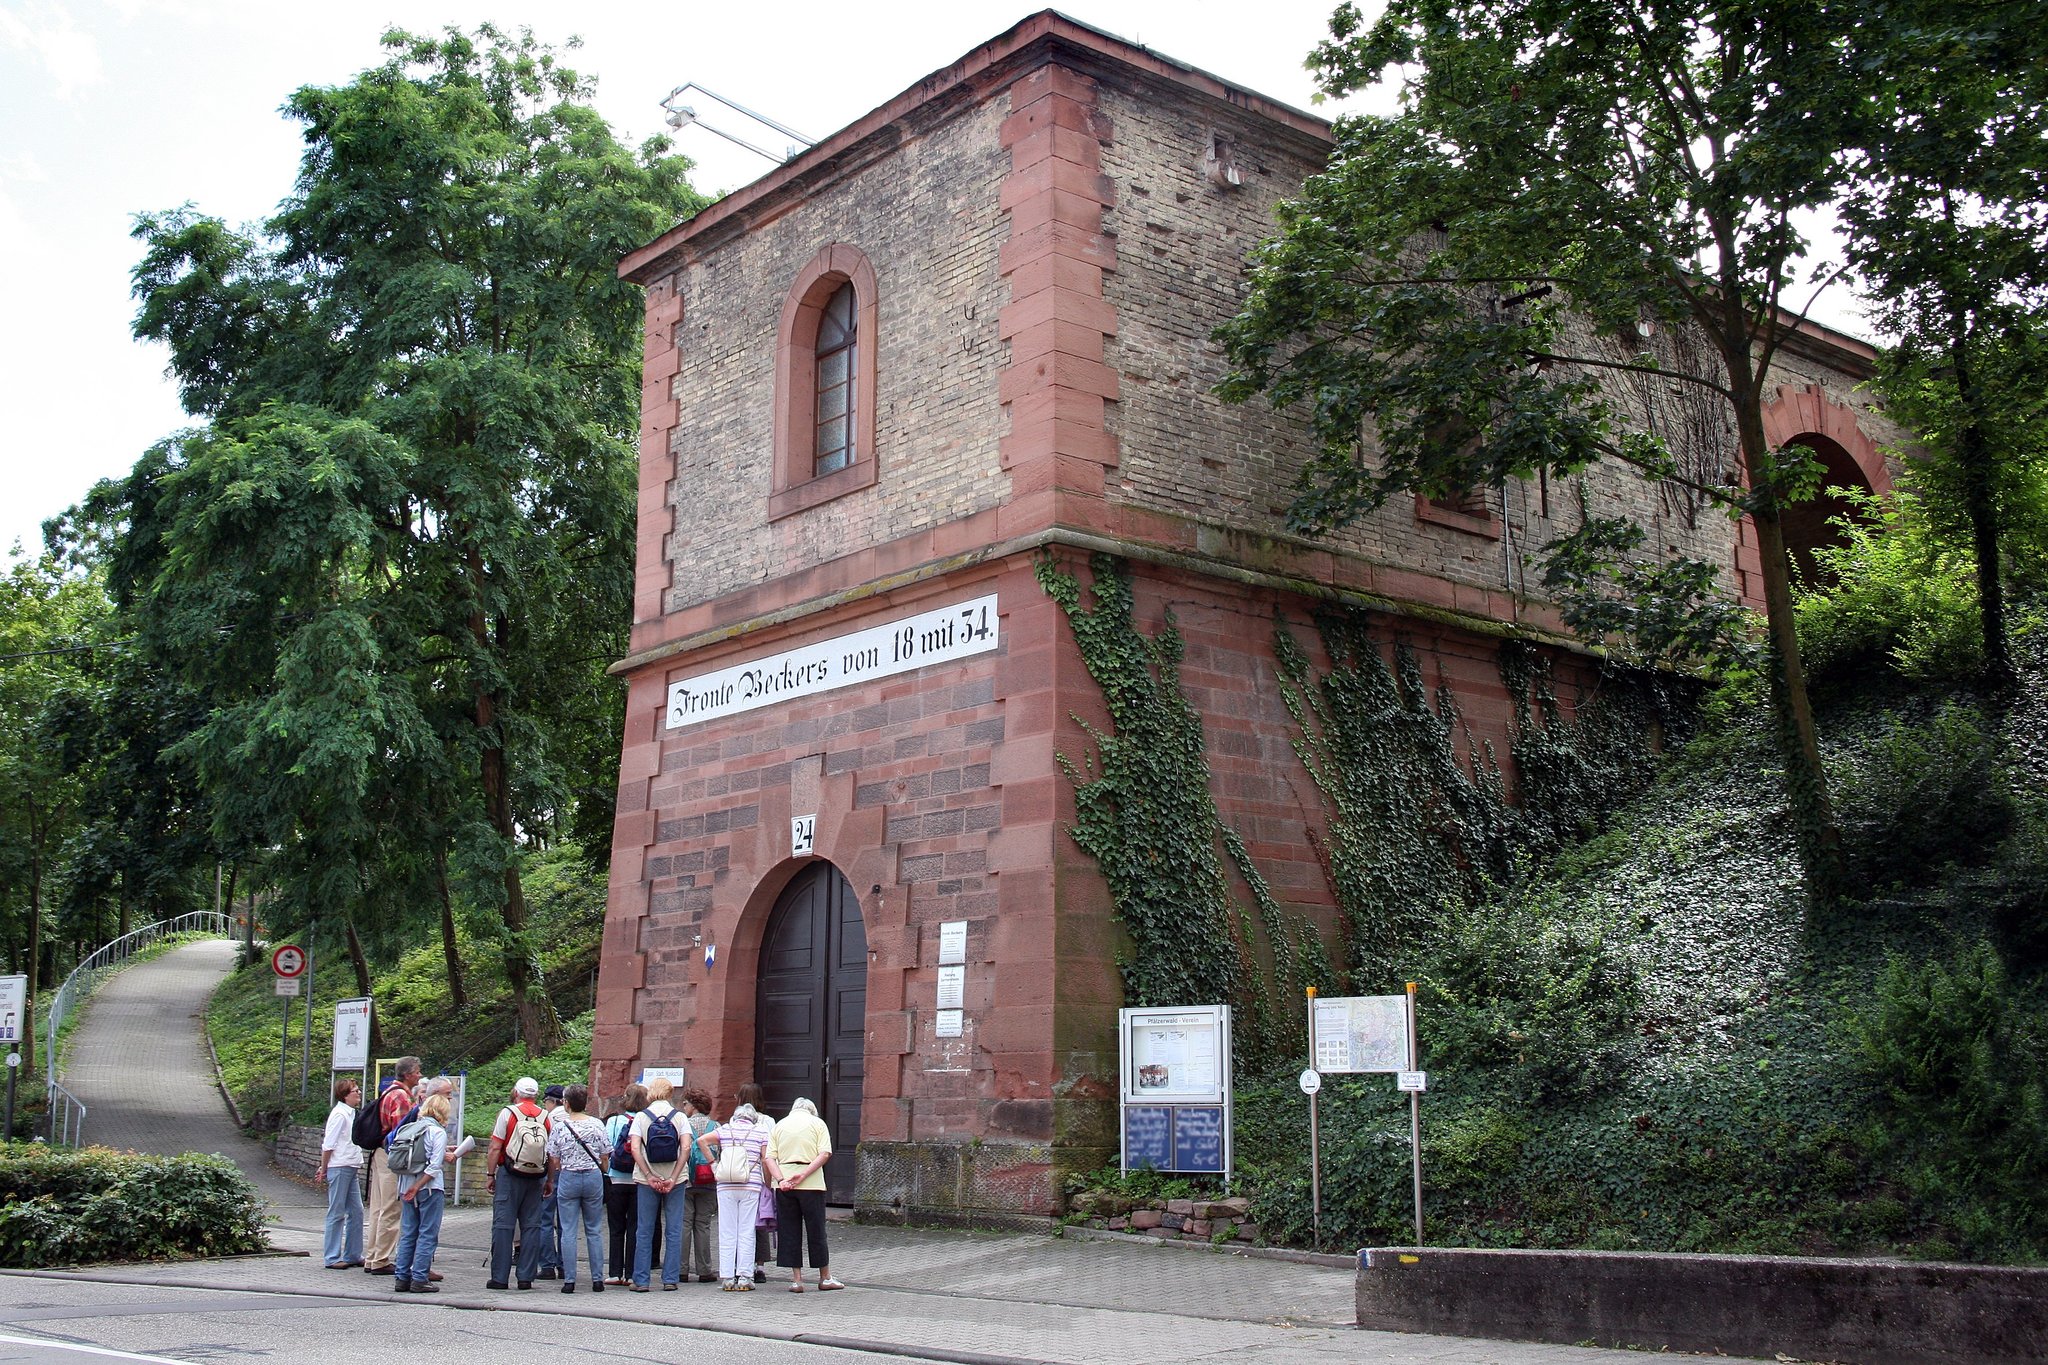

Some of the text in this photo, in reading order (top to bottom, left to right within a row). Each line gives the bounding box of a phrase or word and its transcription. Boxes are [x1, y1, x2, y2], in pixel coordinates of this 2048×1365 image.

[672, 605, 994, 723] Fronte Beckers von 18 mit 34.
[794, 820, 812, 850] 24
